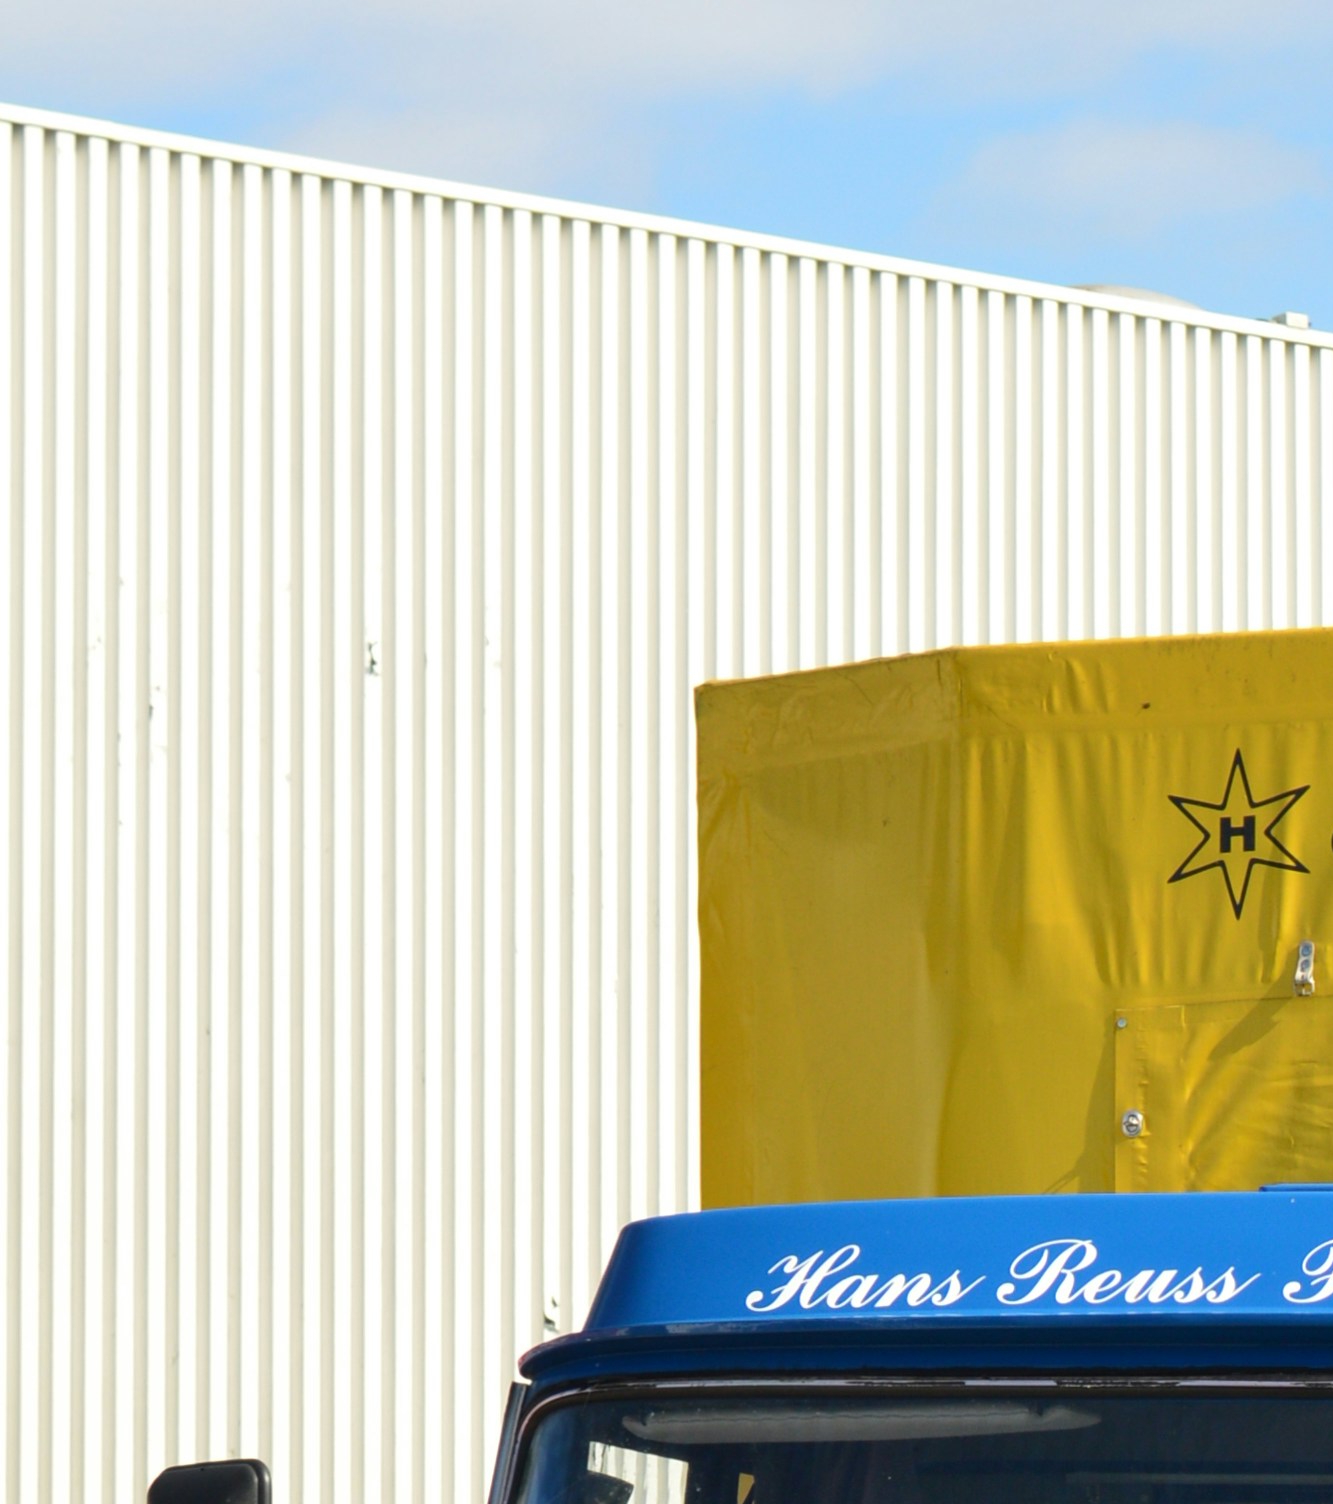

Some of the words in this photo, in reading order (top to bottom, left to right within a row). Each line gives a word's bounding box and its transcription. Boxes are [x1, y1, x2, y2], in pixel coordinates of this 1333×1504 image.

[1219, 815, 1256, 853] H
[745, 1244, 986, 1312] Hans
[997, 1239, 1262, 1306] Reuss
